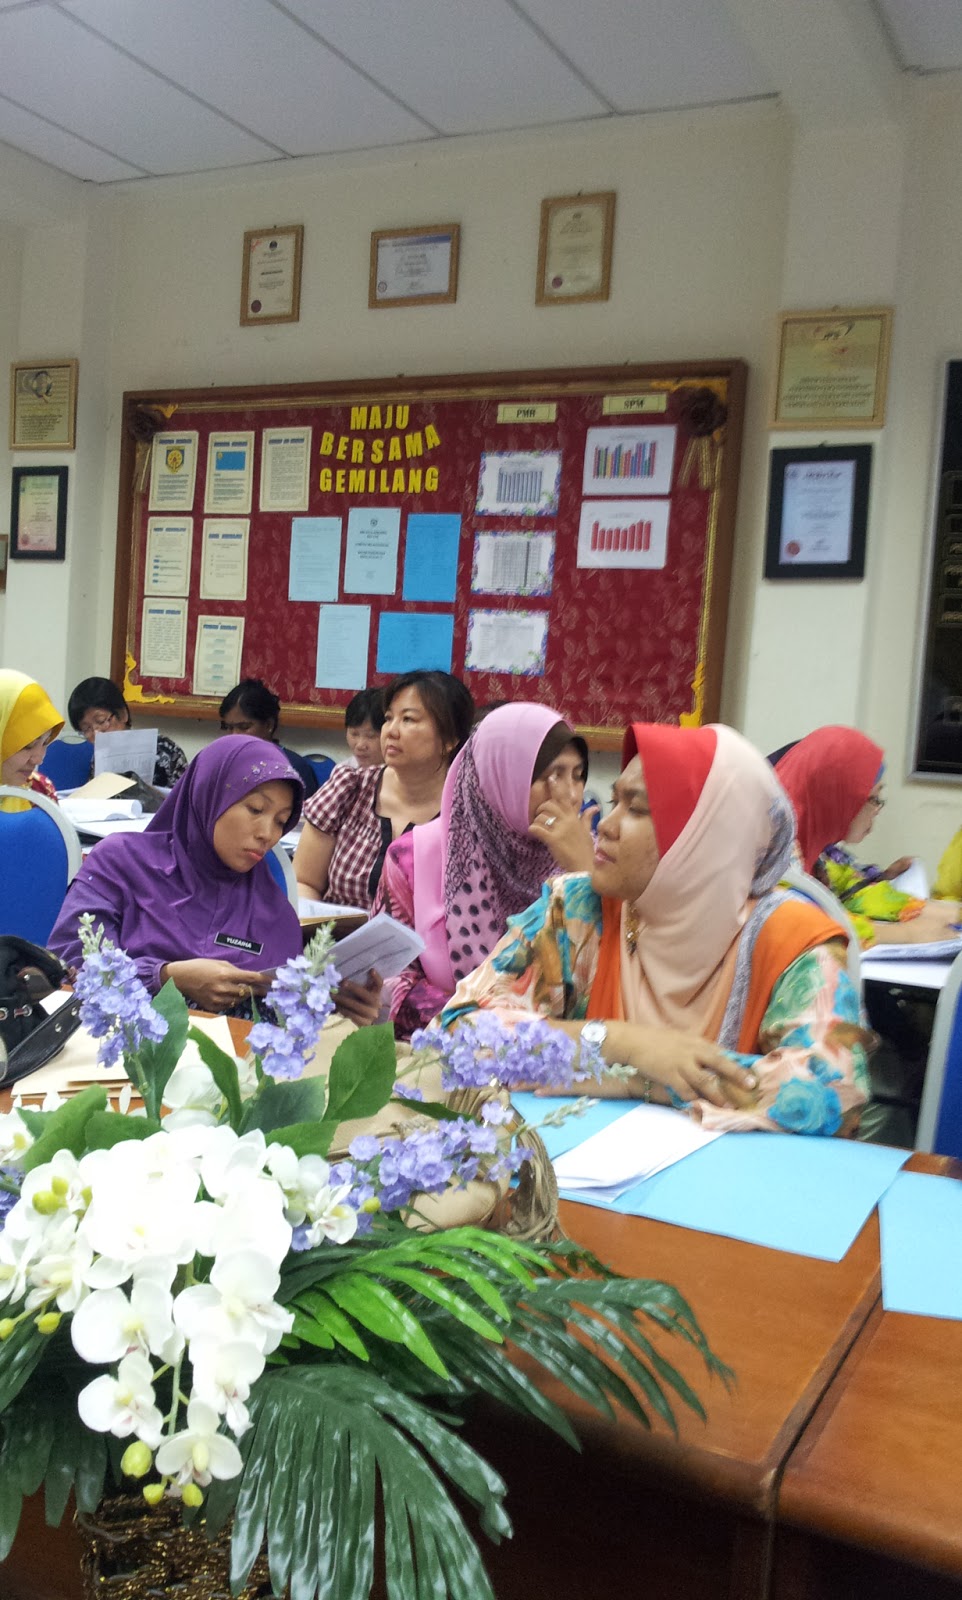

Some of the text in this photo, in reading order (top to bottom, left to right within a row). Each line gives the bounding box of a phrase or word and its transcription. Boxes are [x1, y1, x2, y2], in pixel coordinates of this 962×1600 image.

[350, 405, 410, 430] MAJU
[319, 424, 441, 464] BERSAMA
[319, 468, 440, 494] GEMILANG
